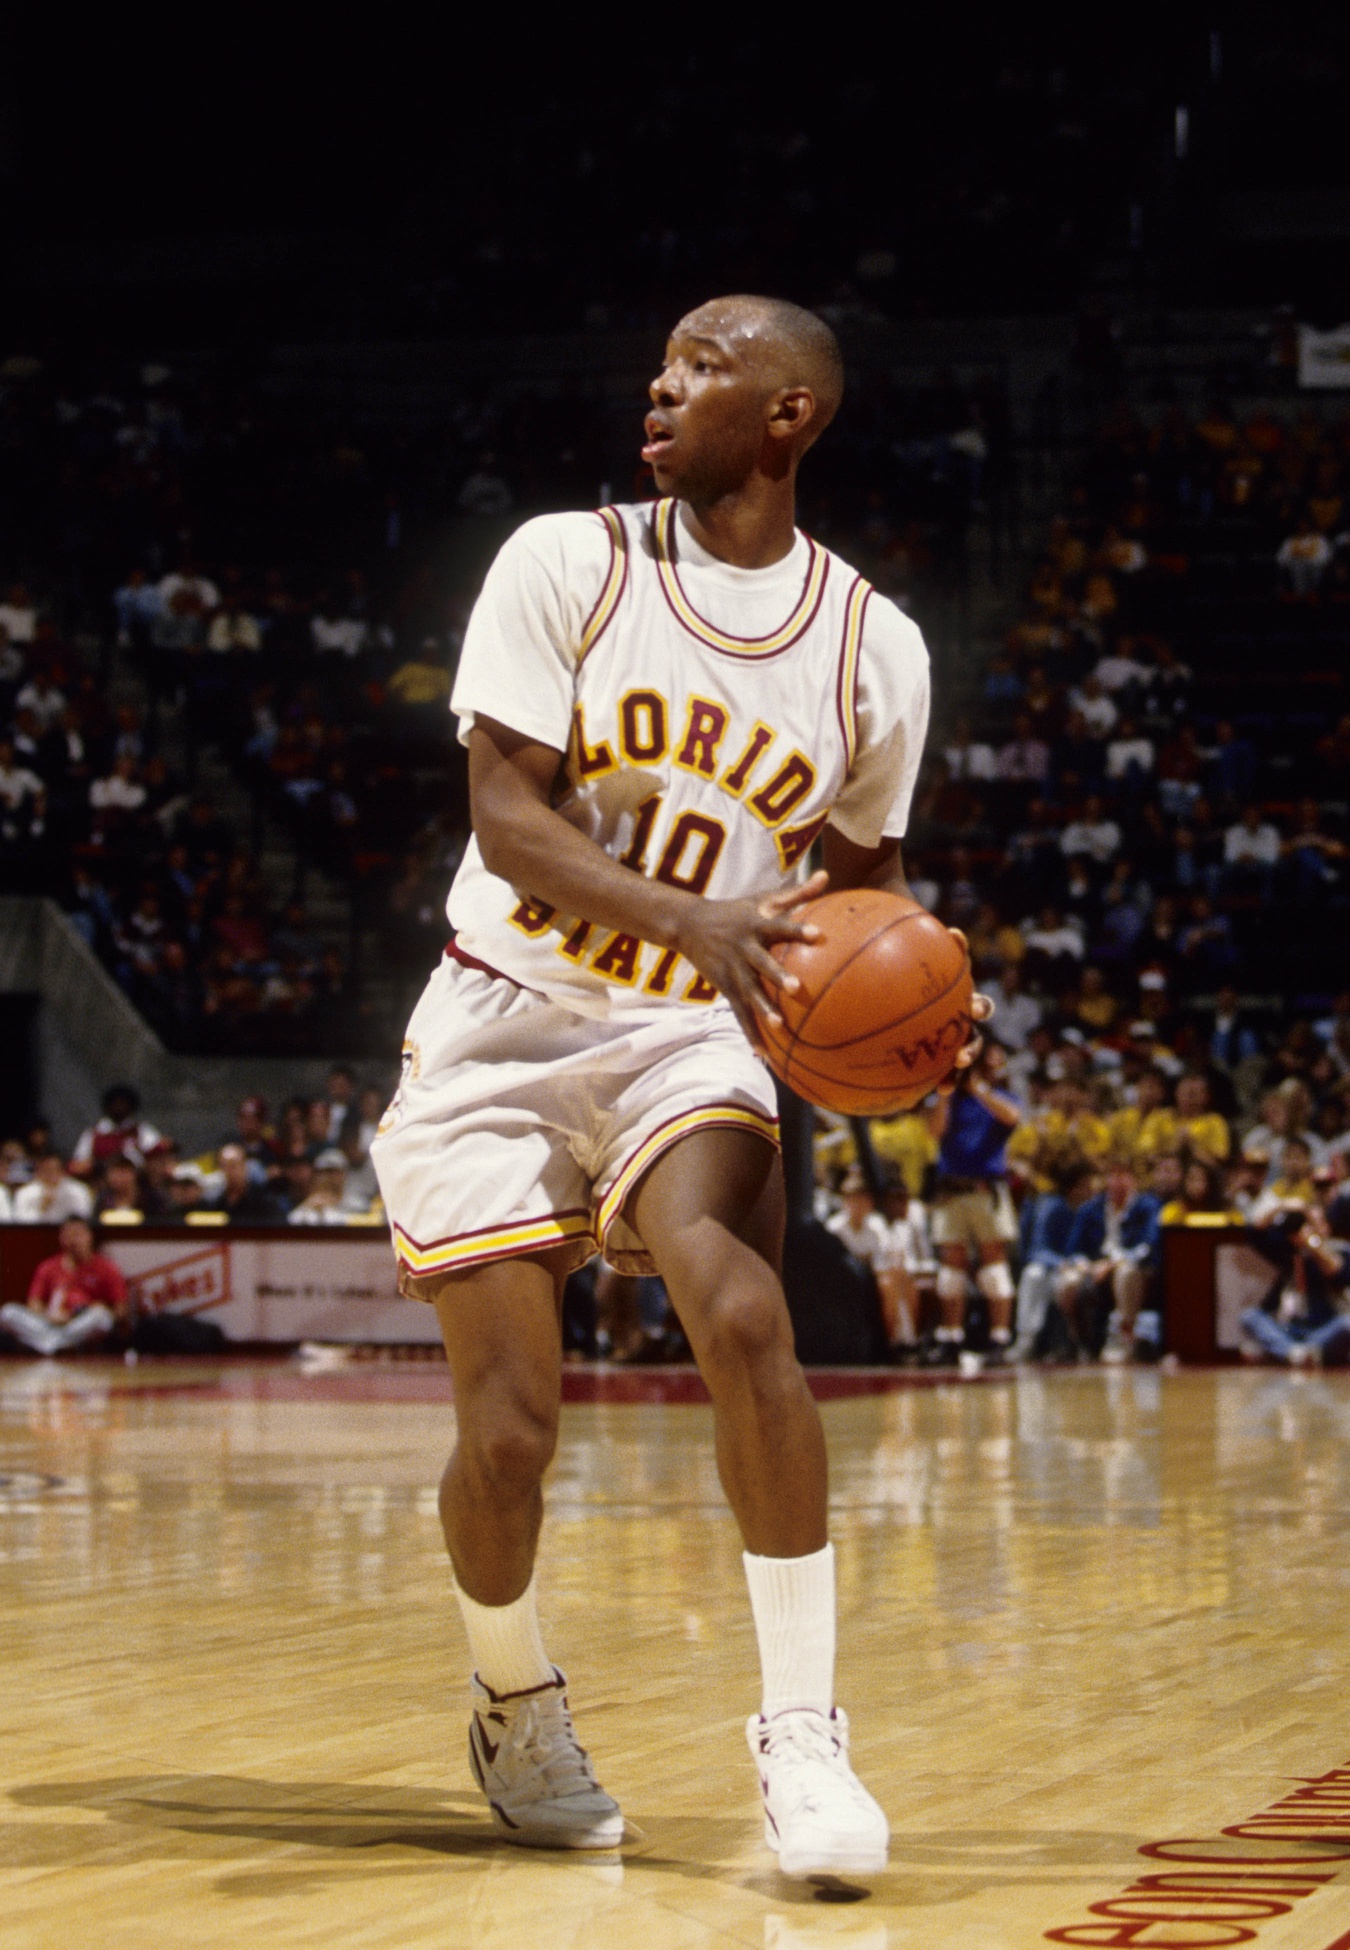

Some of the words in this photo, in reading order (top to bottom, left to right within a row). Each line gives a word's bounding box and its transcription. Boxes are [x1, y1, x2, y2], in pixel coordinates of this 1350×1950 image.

[571, 688, 830, 872] LORIDA
[620, 793, 727, 897] 10
[1042, 1872, 1340, 1950] eon
